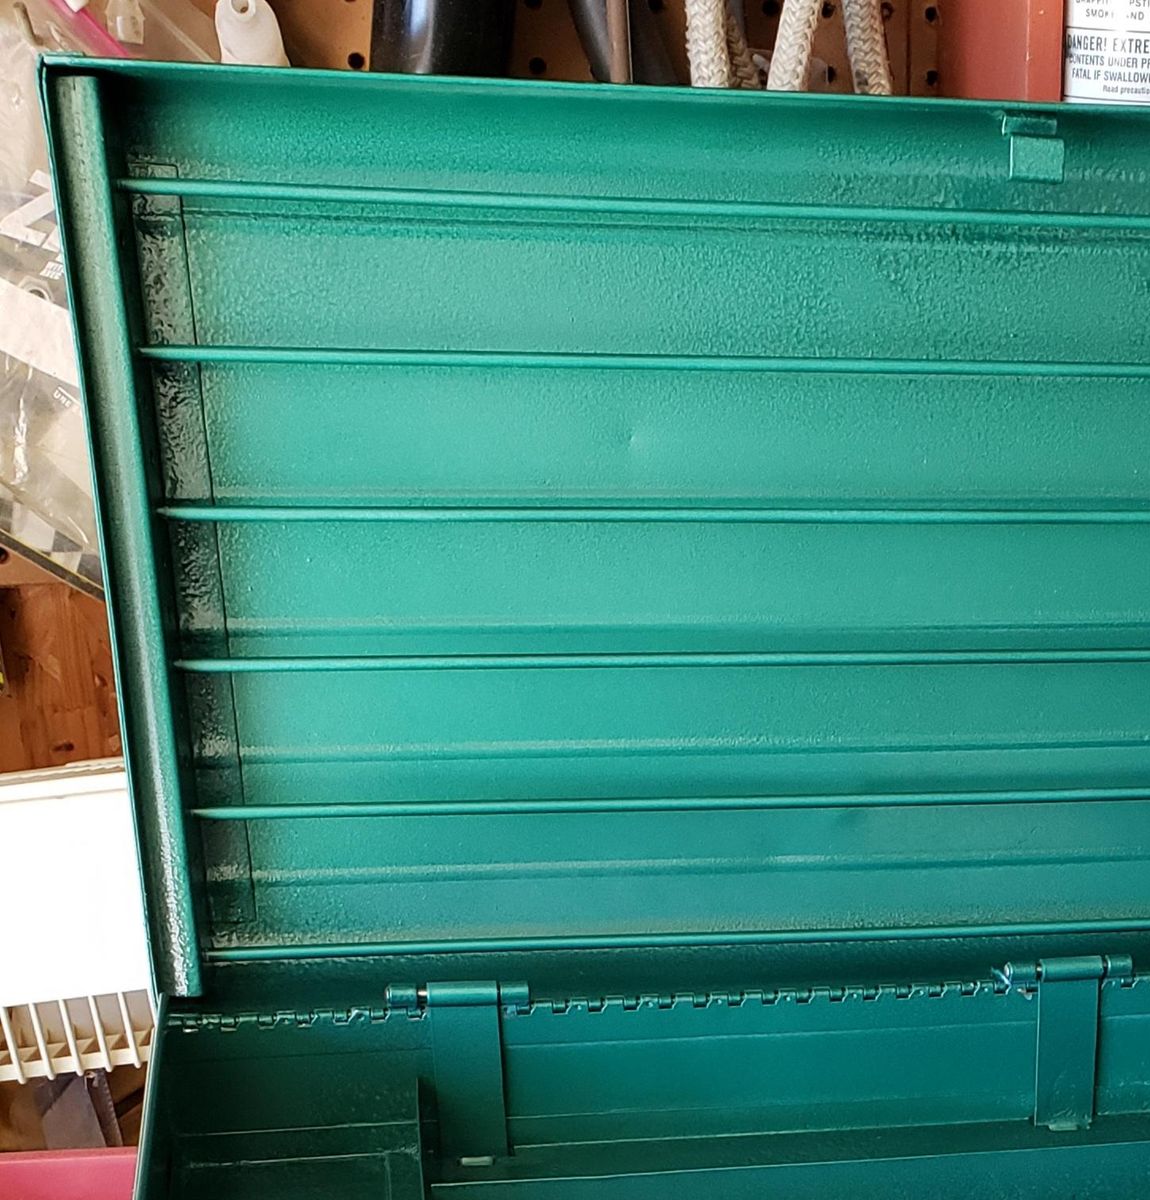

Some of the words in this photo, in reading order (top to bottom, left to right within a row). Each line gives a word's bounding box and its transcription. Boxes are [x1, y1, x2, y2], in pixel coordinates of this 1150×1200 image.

[1065, 33, 1108, 52] DANGER!
[1107, 56, 1139, 69] UNDER
[1071, 67, 1092, 80] FATAL
[1093, 69, 1102, 80] IF
